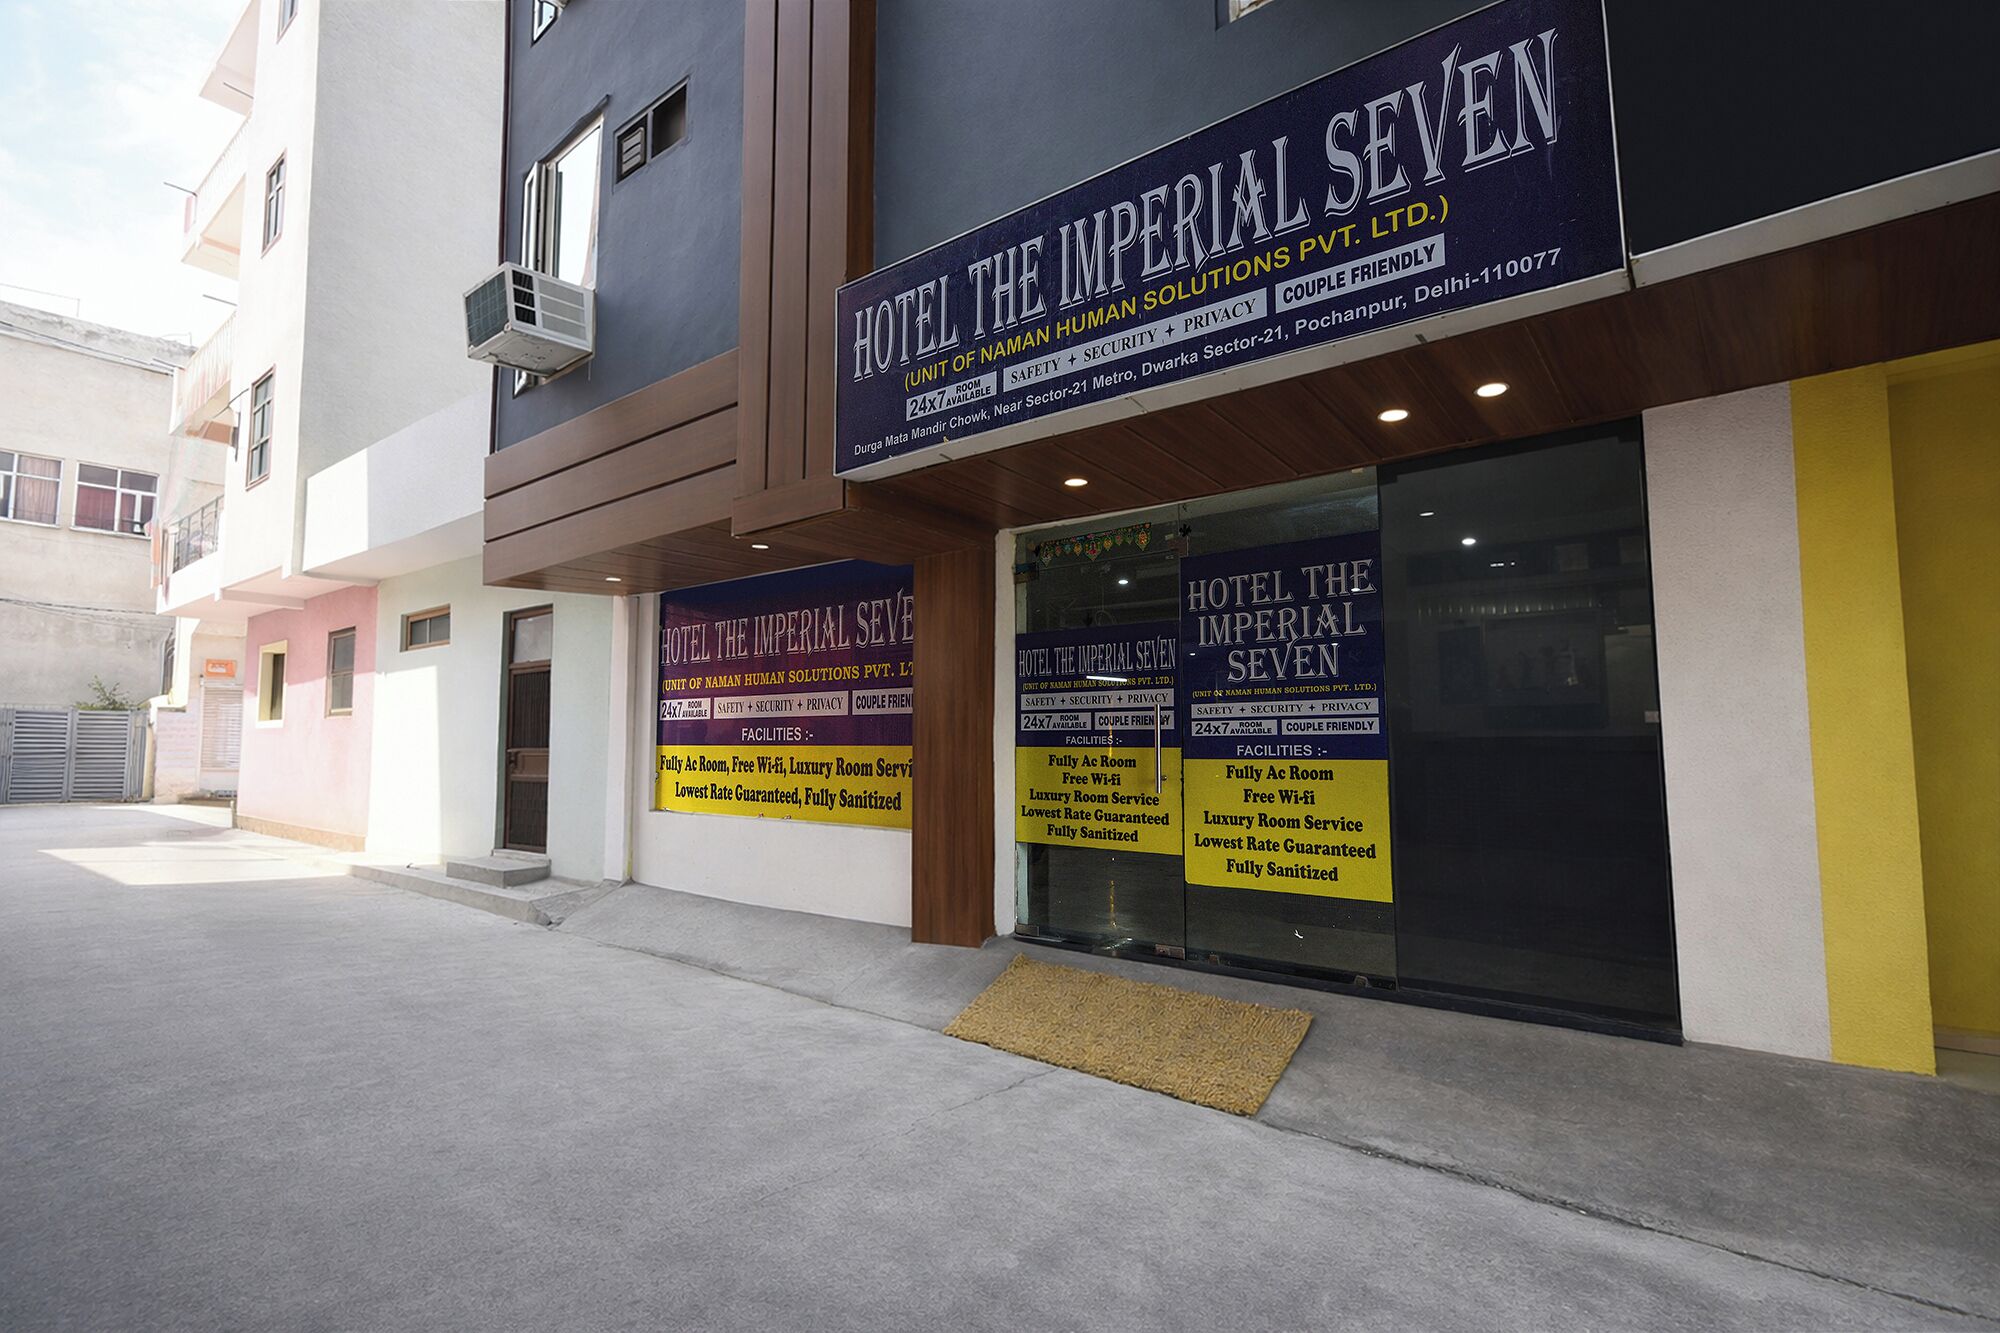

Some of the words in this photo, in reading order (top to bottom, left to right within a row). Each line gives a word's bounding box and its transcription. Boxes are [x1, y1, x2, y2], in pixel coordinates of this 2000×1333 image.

[853, 274, 960, 382] HOTEL
[967, 235, 1047, 340] THE
[1058, 136, 1310, 311] IMPERIAL
[1324, 27, 1559, 218] SEVEN
[1283, 270, 1346, 304] COUPLE
[1351, 243, 1436, 285] FRIENDLY
[905, 361, 949, 392] (UNIT
[953, 351, 975, 372] OF
[981, 325, 1049, 369] NAMAN
[1056, 297, 1136, 339] HUMAN
[1143, 246, 1291, 311] SOLUTIONS
[1300, 224, 1361, 261] PVT.
[1372, 194, 1449, 239] LTD.)
[1011, 357, 1060, 384] SAFETY
[1083, 328, 1158, 363] SECURITY
[1184, 299, 1256, 334] PRIVACY
[854, 440, 883, 456] Durga
[885, 433, 909, 448] Mata
[911, 421, 947, 440] Mandir
[949, 408, 991, 429] Chowk,
[994, 400, 1023, 417] Near
[1025, 379, 1087, 408] Sector-21
[1092, 370, 1137, 390] Metro,
[1142, 351, 1199, 377] Dwarka
[1203, 325, 1288, 360] Sector-21,
[1295, 295, 1407, 335] Pochanpur,
[1415, 247, 1562, 303] Delhi-110077
[956, 379, 981, 394] ROOM
[910, 390, 946, 418] 24x7
[946, 386, 991, 407] AVAILABLE
[1188, 570, 1295, 613] HOTEL
[1301, 558, 1378, 600] THE
[1198, 601, 1367, 647] IMPERIAL
[661, 624, 710, 666] HOTEL
[715, 618, 748, 661] THE
[753, 605, 851, 657] IMPERIAL
[1019, 648, 1052, 677] HOTEL
[1054, 646, 1075, 676] THE
[1078, 642, 1134, 674] IMPERIAL
[1136, 635, 1176, 671] SEVEN
[1227, 638, 1340, 682] SEVEN
[662, 679, 686, 694] (UNIT
[689, 678, 702, 689] OF
[705, 675, 741, 688] NAMAN
[744, 671, 785, 686] HUMAN
[789, 666, 859, 683] SOLUTIONS
[864, 663, 894, 678] PVT.
[1023, 682, 1038, 692] (UNIT
[1049, 681, 1072, 689] NAMAN
[1074, 680, 1097, 688] HUMAN
[1138, 677, 1153, 685] PVT.
[1155, 676, 1174, 685] LTD.)
[1026, 697, 1056, 706] SAFETY
[1069, 695, 1113, 705] SECURITY
[1128, 693, 1168, 703] PRIVACY
[1192, 690, 1212, 699] (UNIT
[1254, 687, 1282, 695] HUMAN
[1284, 685, 1330, 694] SOLUTIONS
[1332, 684, 1352, 692] PVT.
[1354, 683, 1377, 692] LTD.)
[688, 701, 702, 709] ROOM
[718, 702, 744, 713] SAFETY
[755, 699, 794, 713] SECURITY
[807, 697, 843, 710] PRIVACY
[856, 695, 886, 709] COUPLE
[888, 693, 913, 708] FRIEN
[1197, 706, 1234, 715] SAFETY
[1250, 704, 1303, 714] SECURITY
[1322, 702, 1371, 711] PRIVACY
[662, 702, 682, 718] 24x7
[682, 710, 707, 718] AVAILABLE
[1023, 715, 1053, 729] 24x7
[1099, 715, 1129, 726] COUPLE
[1131, 715, 1170, 725] FRIENLY
[1195, 722, 1230, 735] 24x7
[1286, 722, 1324, 732] COUPLE
[1326, 721, 1375, 731] FRIENDLY
[742, 727, 802, 741] FACILITIES
[1230, 727, 1272, 735] AVAILABLE
[1065, 736, 1113, 745] FACILITIES
[1236, 744, 1313, 756] FACILITIES
[660, 755, 683, 774] Fully
[685, 755, 697, 772] Ac
[699, 755, 730, 776] Room,
[732, 756, 754, 773] Free
[757, 756, 787, 778] Wi-fi,
[789, 756, 833, 779] Luxury
[836, 757, 873, 777] Room
[1048, 754, 1078, 769] Fully
[1081, 755, 1098, 767] Ac
[1100, 755, 1137, 768] Room
[1062, 772, 1088, 785] Free
[1091, 773, 1121, 786] Wi-fi
[1226, 765, 1263, 782] Fully
[1266, 765, 1286, 780] Ac
[1289, 765, 1334, 781] Room
[675, 781, 708, 799] Lowest
[710, 783, 733, 801] Rate
[735, 784, 802, 809] Guaranteed,
[805, 787, 837, 811] Fully
[839, 789, 902, 811] Sanitized
[1029, 788, 1071, 804] Luxury
[1073, 790, 1109, 804] Room
[1112, 792, 1160, 806] Service
[1243, 789, 1275, 804] Free
[1278, 789, 1316, 805] Wi-fi
[1021, 805, 1062, 819] Lowest
[1064, 807, 1092, 821] Rate
[1094, 809, 1170, 826] Guaranteed
[1203, 811, 1255, 829] Luxury
[1258, 813, 1301, 829] Room
[1304, 815, 1364, 832] Service
[1047, 824, 1077, 840] Fully
[1080, 827, 1139, 842] Sanitized
[1194, 833, 1244, 850] Lowest
[1246, 836, 1280, 852] Rate
[1283, 838, 1377, 859] Guaranteed
[1226, 859, 1264, 878] Fully
[1267, 861, 1339, 882] Sanitized
